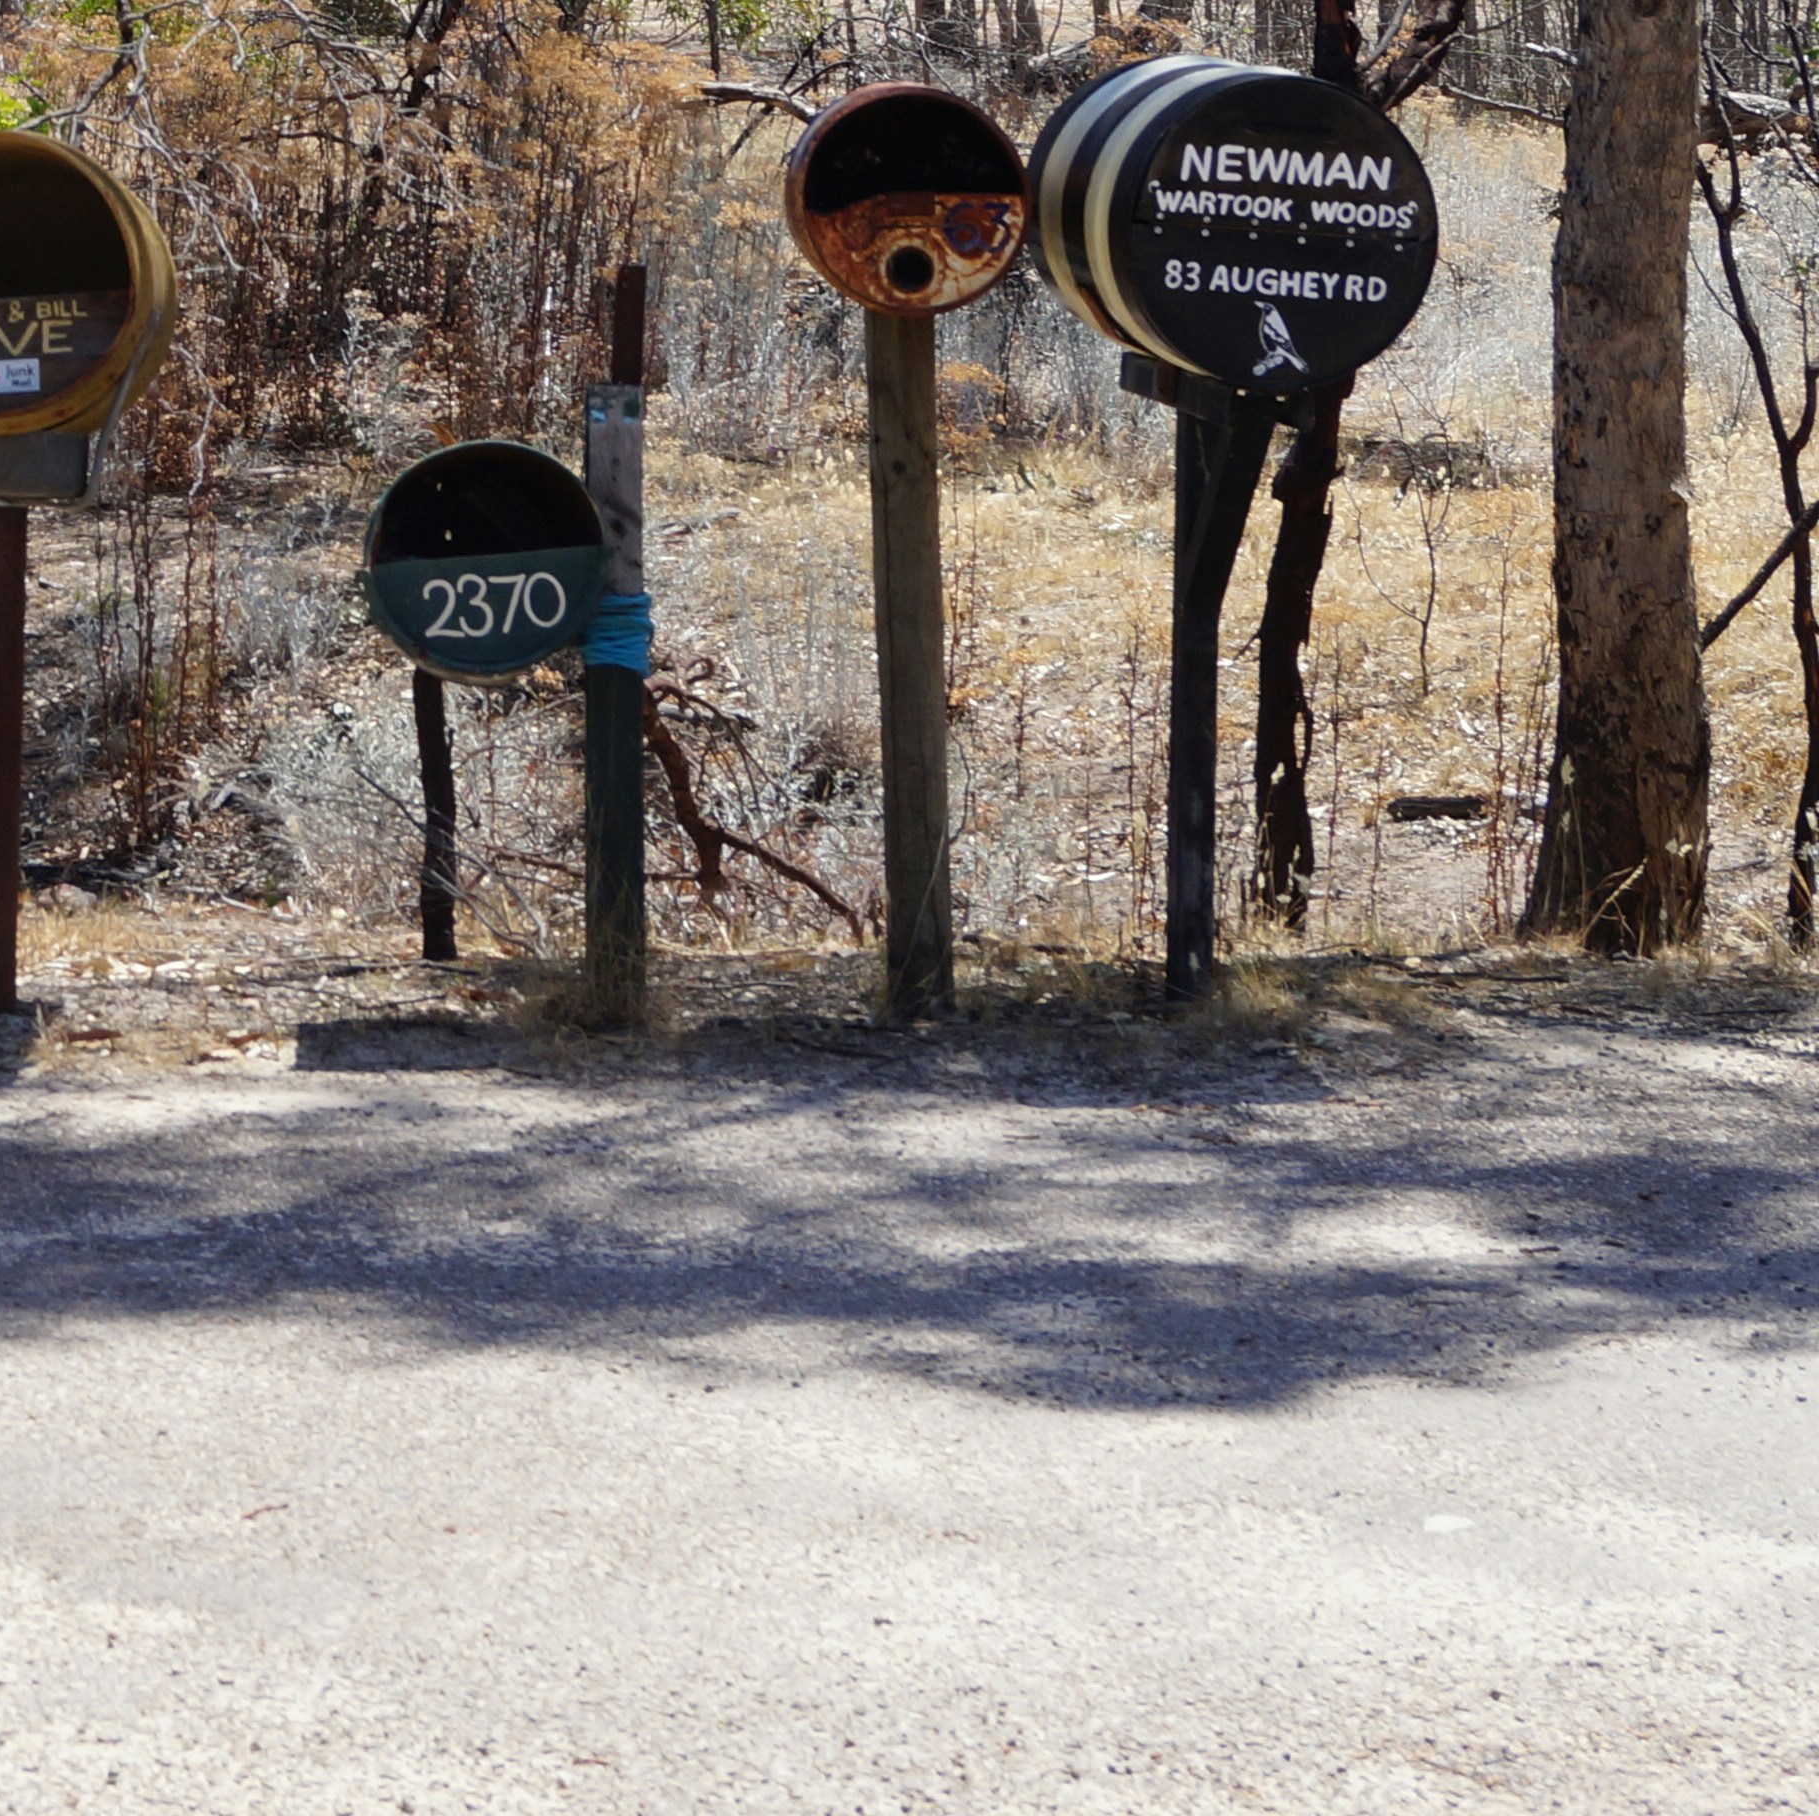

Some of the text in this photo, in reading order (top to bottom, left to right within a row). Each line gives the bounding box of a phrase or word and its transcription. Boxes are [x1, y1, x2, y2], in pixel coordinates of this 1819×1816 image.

[1180, 143, 1392, 191] NEWMAN
[1164, 258, 1388, 303] 83 AUGHEY RD
[7, 299, 25, 323] &
[35, 298, 88, 320] BILL
[422, 571, 567, 639] 2370
